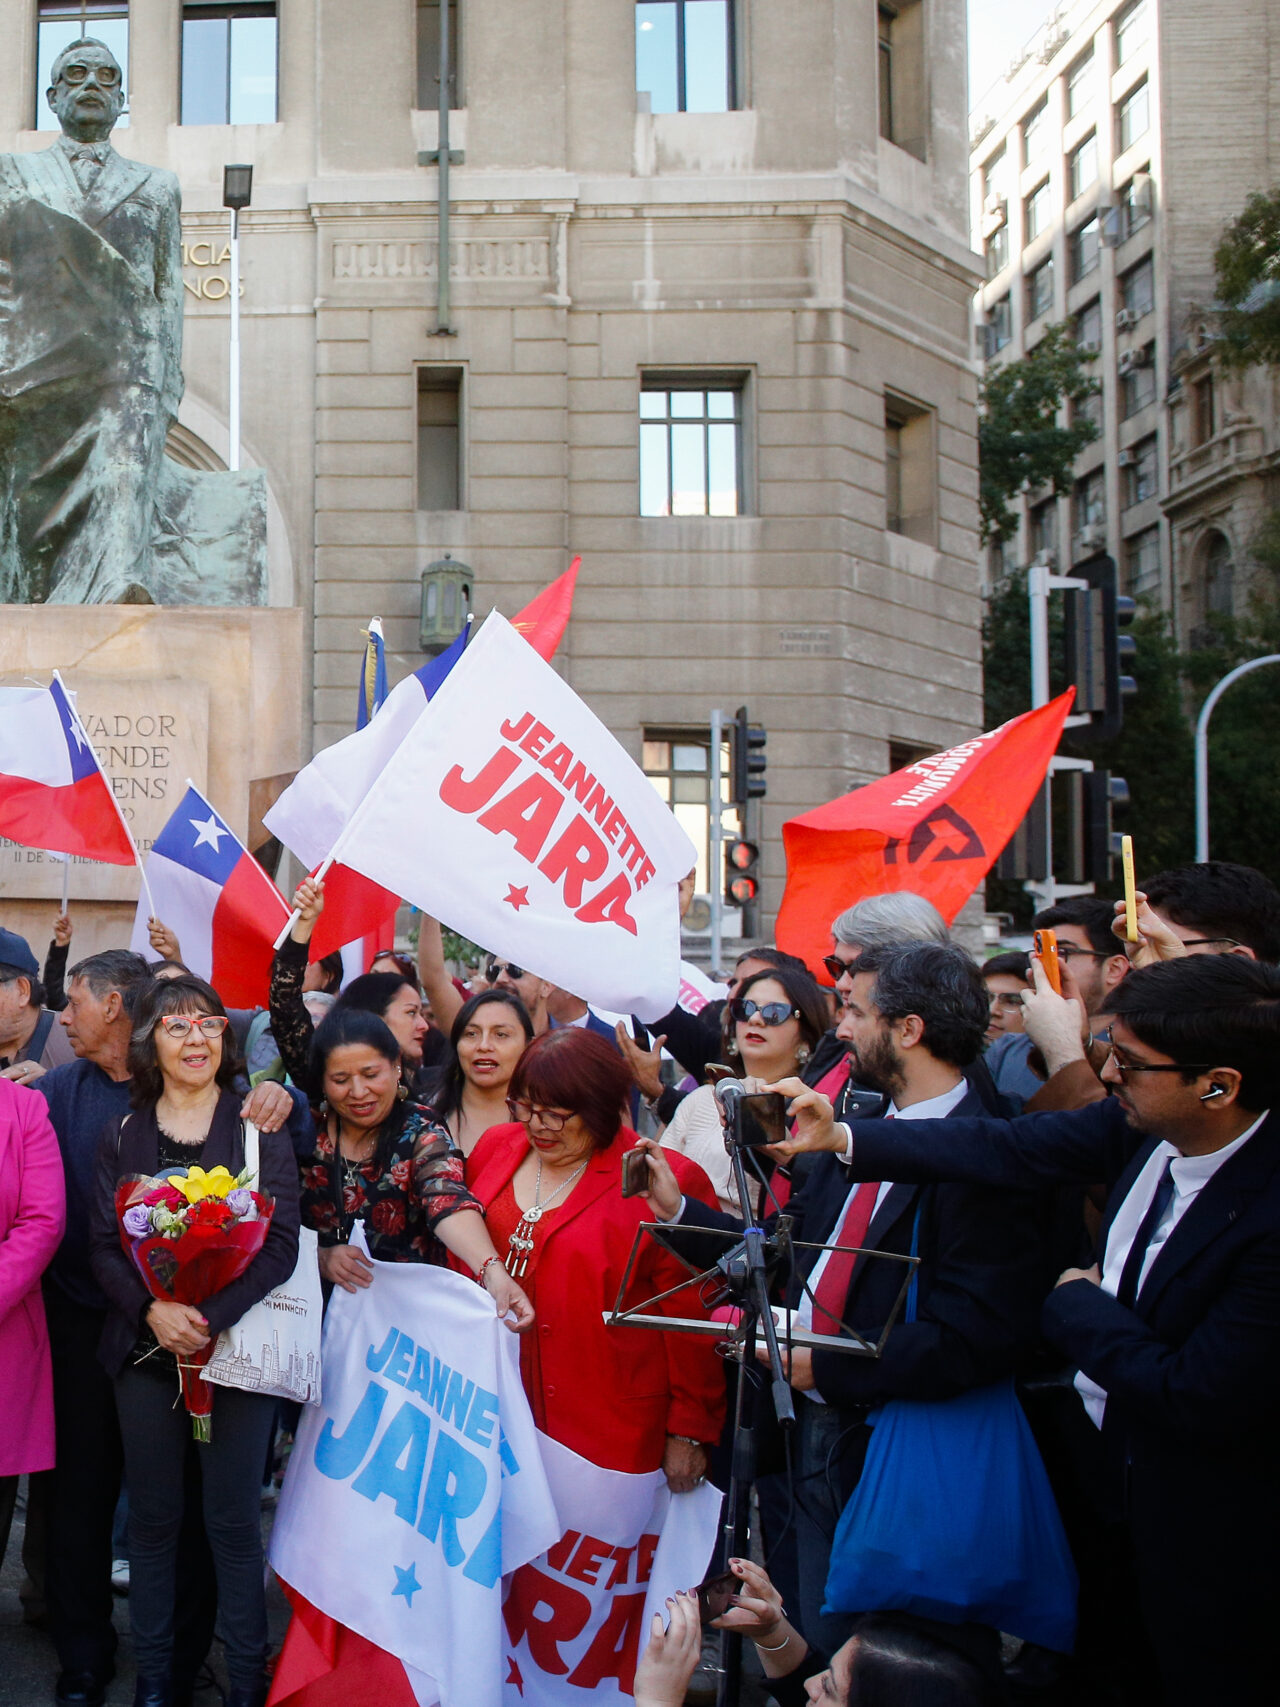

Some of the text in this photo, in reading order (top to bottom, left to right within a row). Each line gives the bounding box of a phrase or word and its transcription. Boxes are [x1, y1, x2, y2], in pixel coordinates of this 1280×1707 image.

[27, 851, 44, 863] DE
[438, 744, 638, 937] JARA
[499, 711, 657, 892] JEANNETTE
